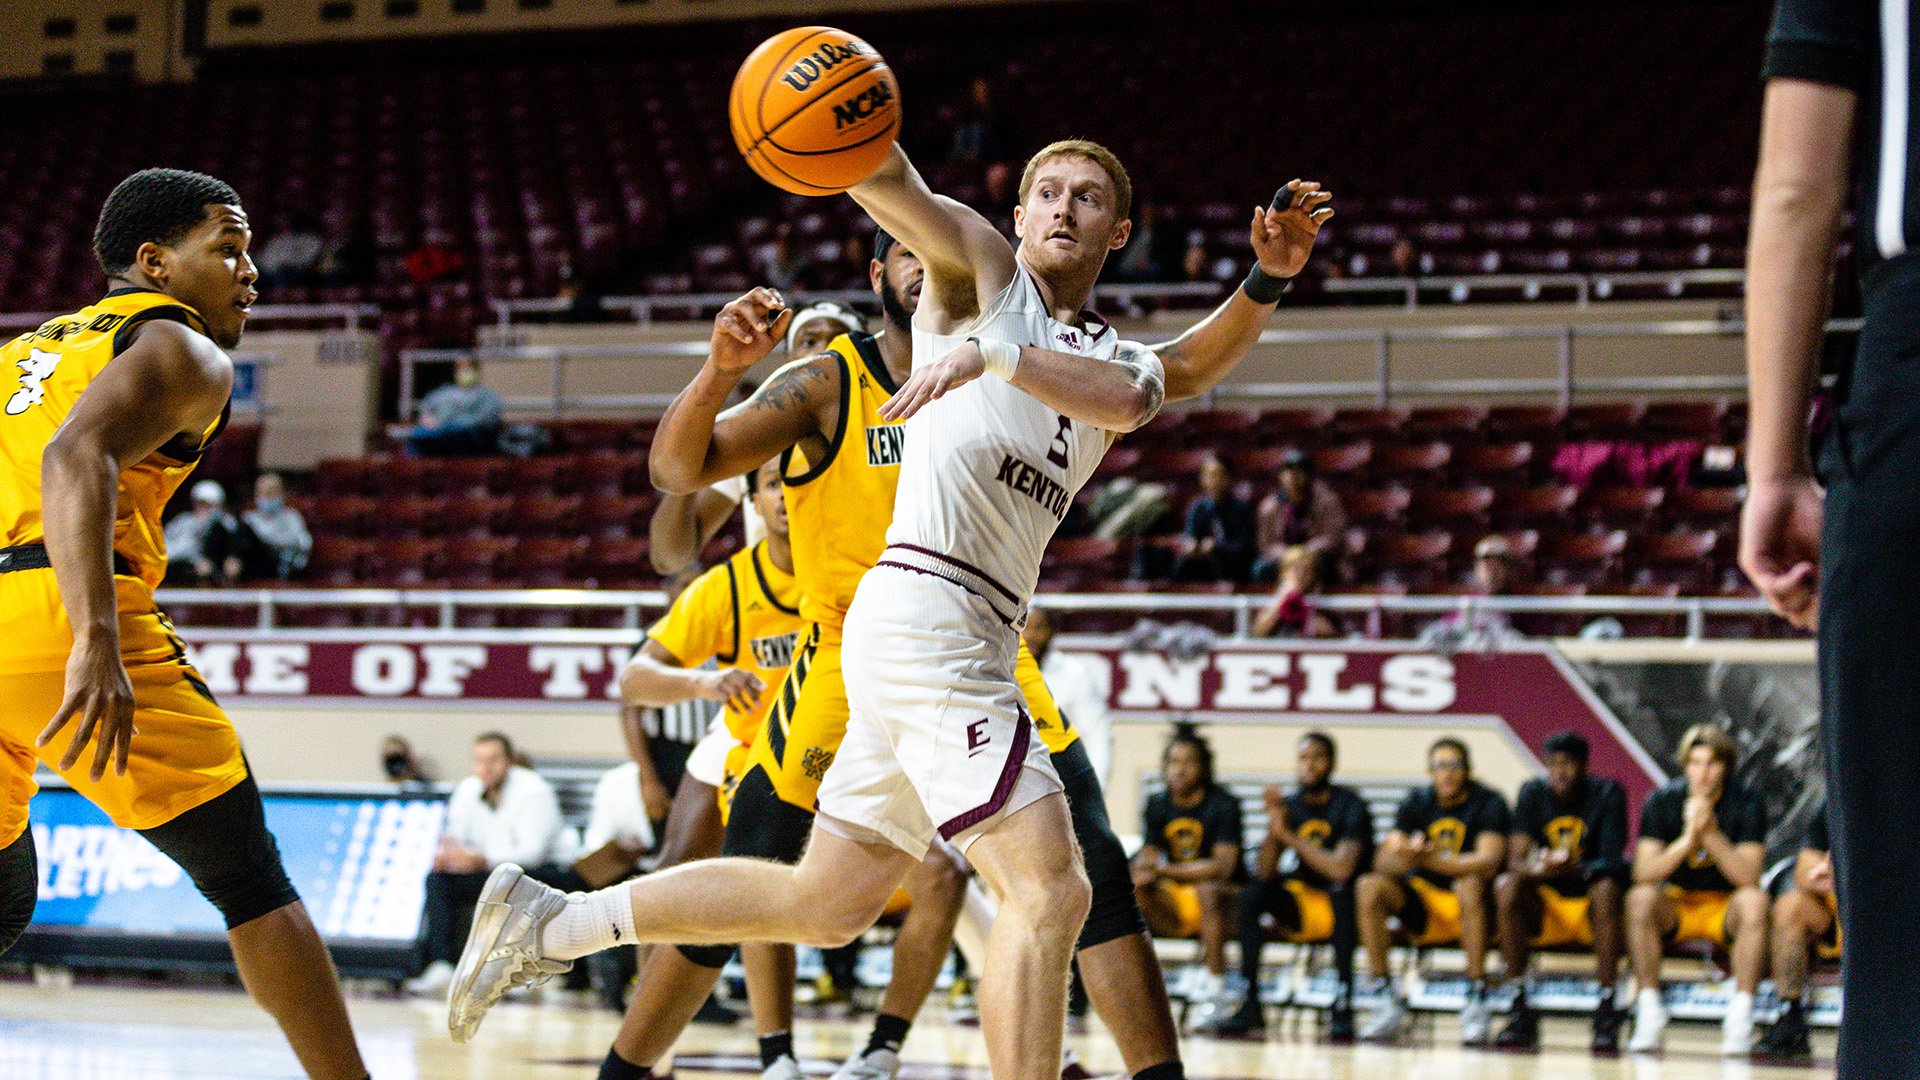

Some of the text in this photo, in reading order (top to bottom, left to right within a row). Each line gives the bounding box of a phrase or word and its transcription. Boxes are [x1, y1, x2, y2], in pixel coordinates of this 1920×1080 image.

[186, 643, 310, 694] ME
[351, 644, 487, 697] OF
[966, 718, 991, 751] E
